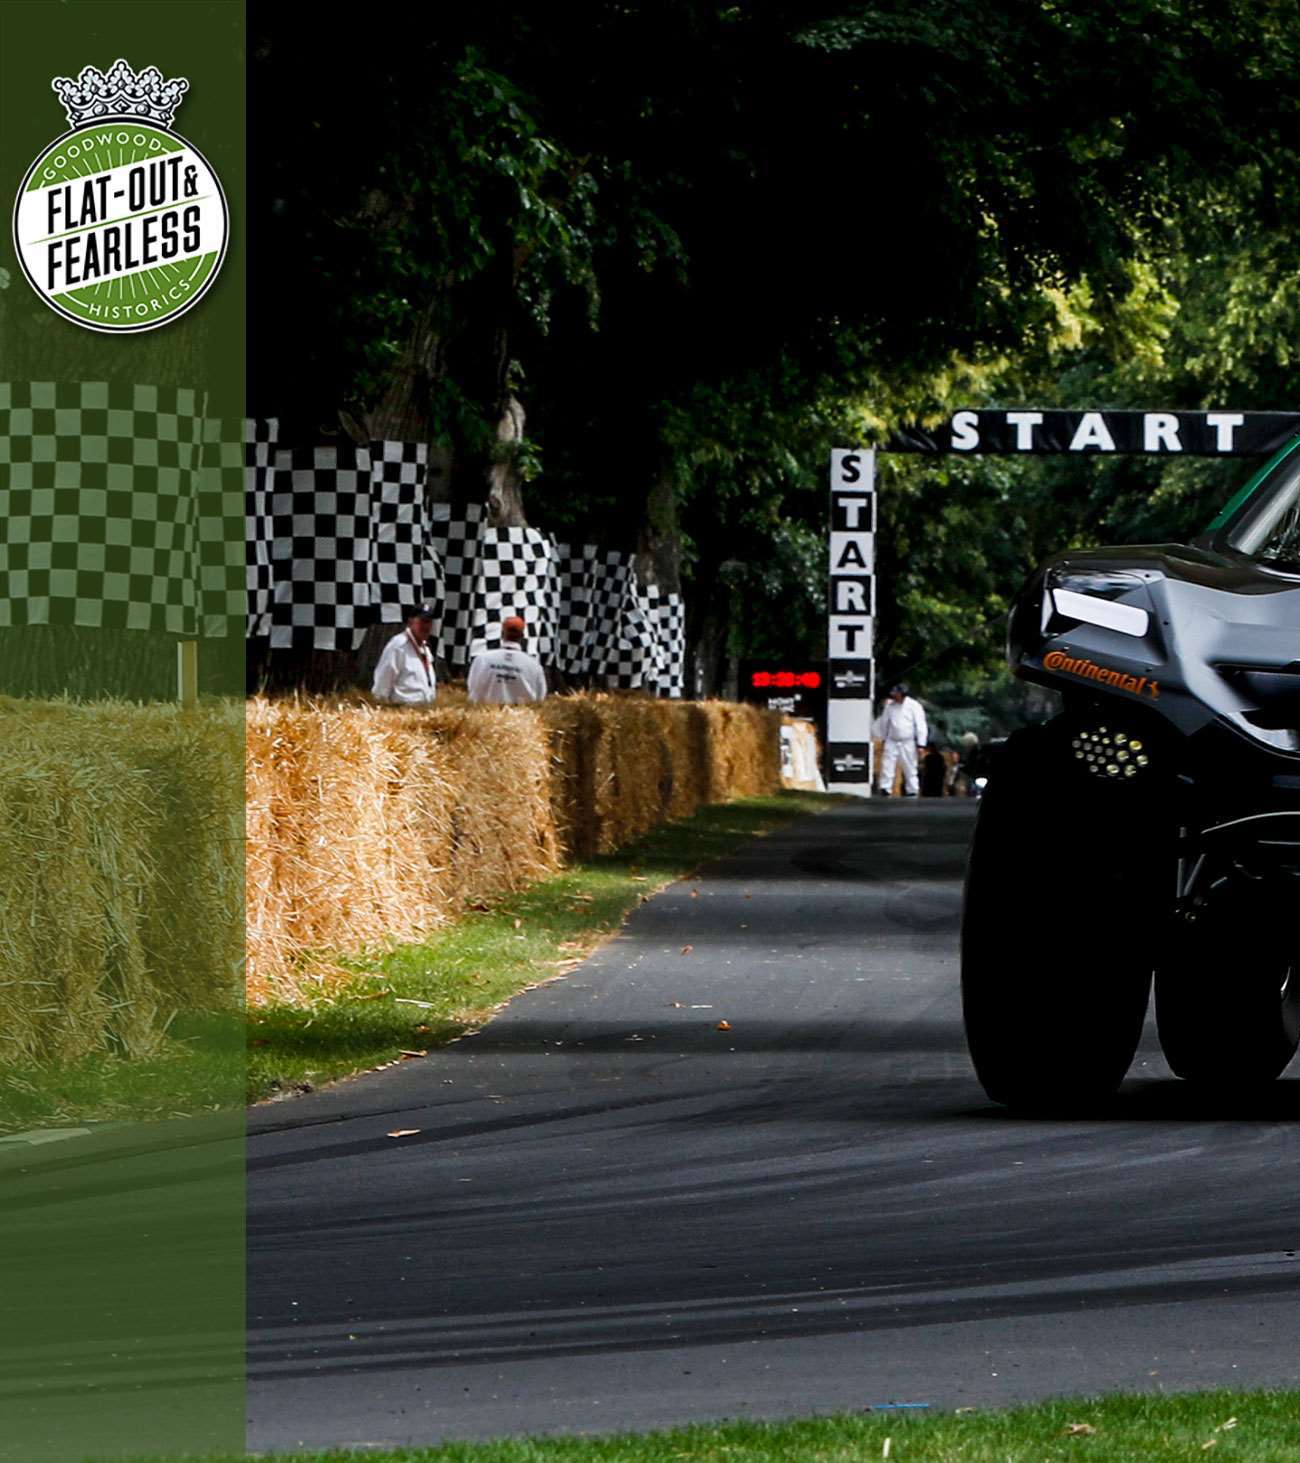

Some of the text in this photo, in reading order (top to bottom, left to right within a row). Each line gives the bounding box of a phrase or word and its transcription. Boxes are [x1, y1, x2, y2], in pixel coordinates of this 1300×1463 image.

[951, 411, 1244, 451] START
[837, 455, 867, 652] START
[1043, 651, 1147, 696] Continental
